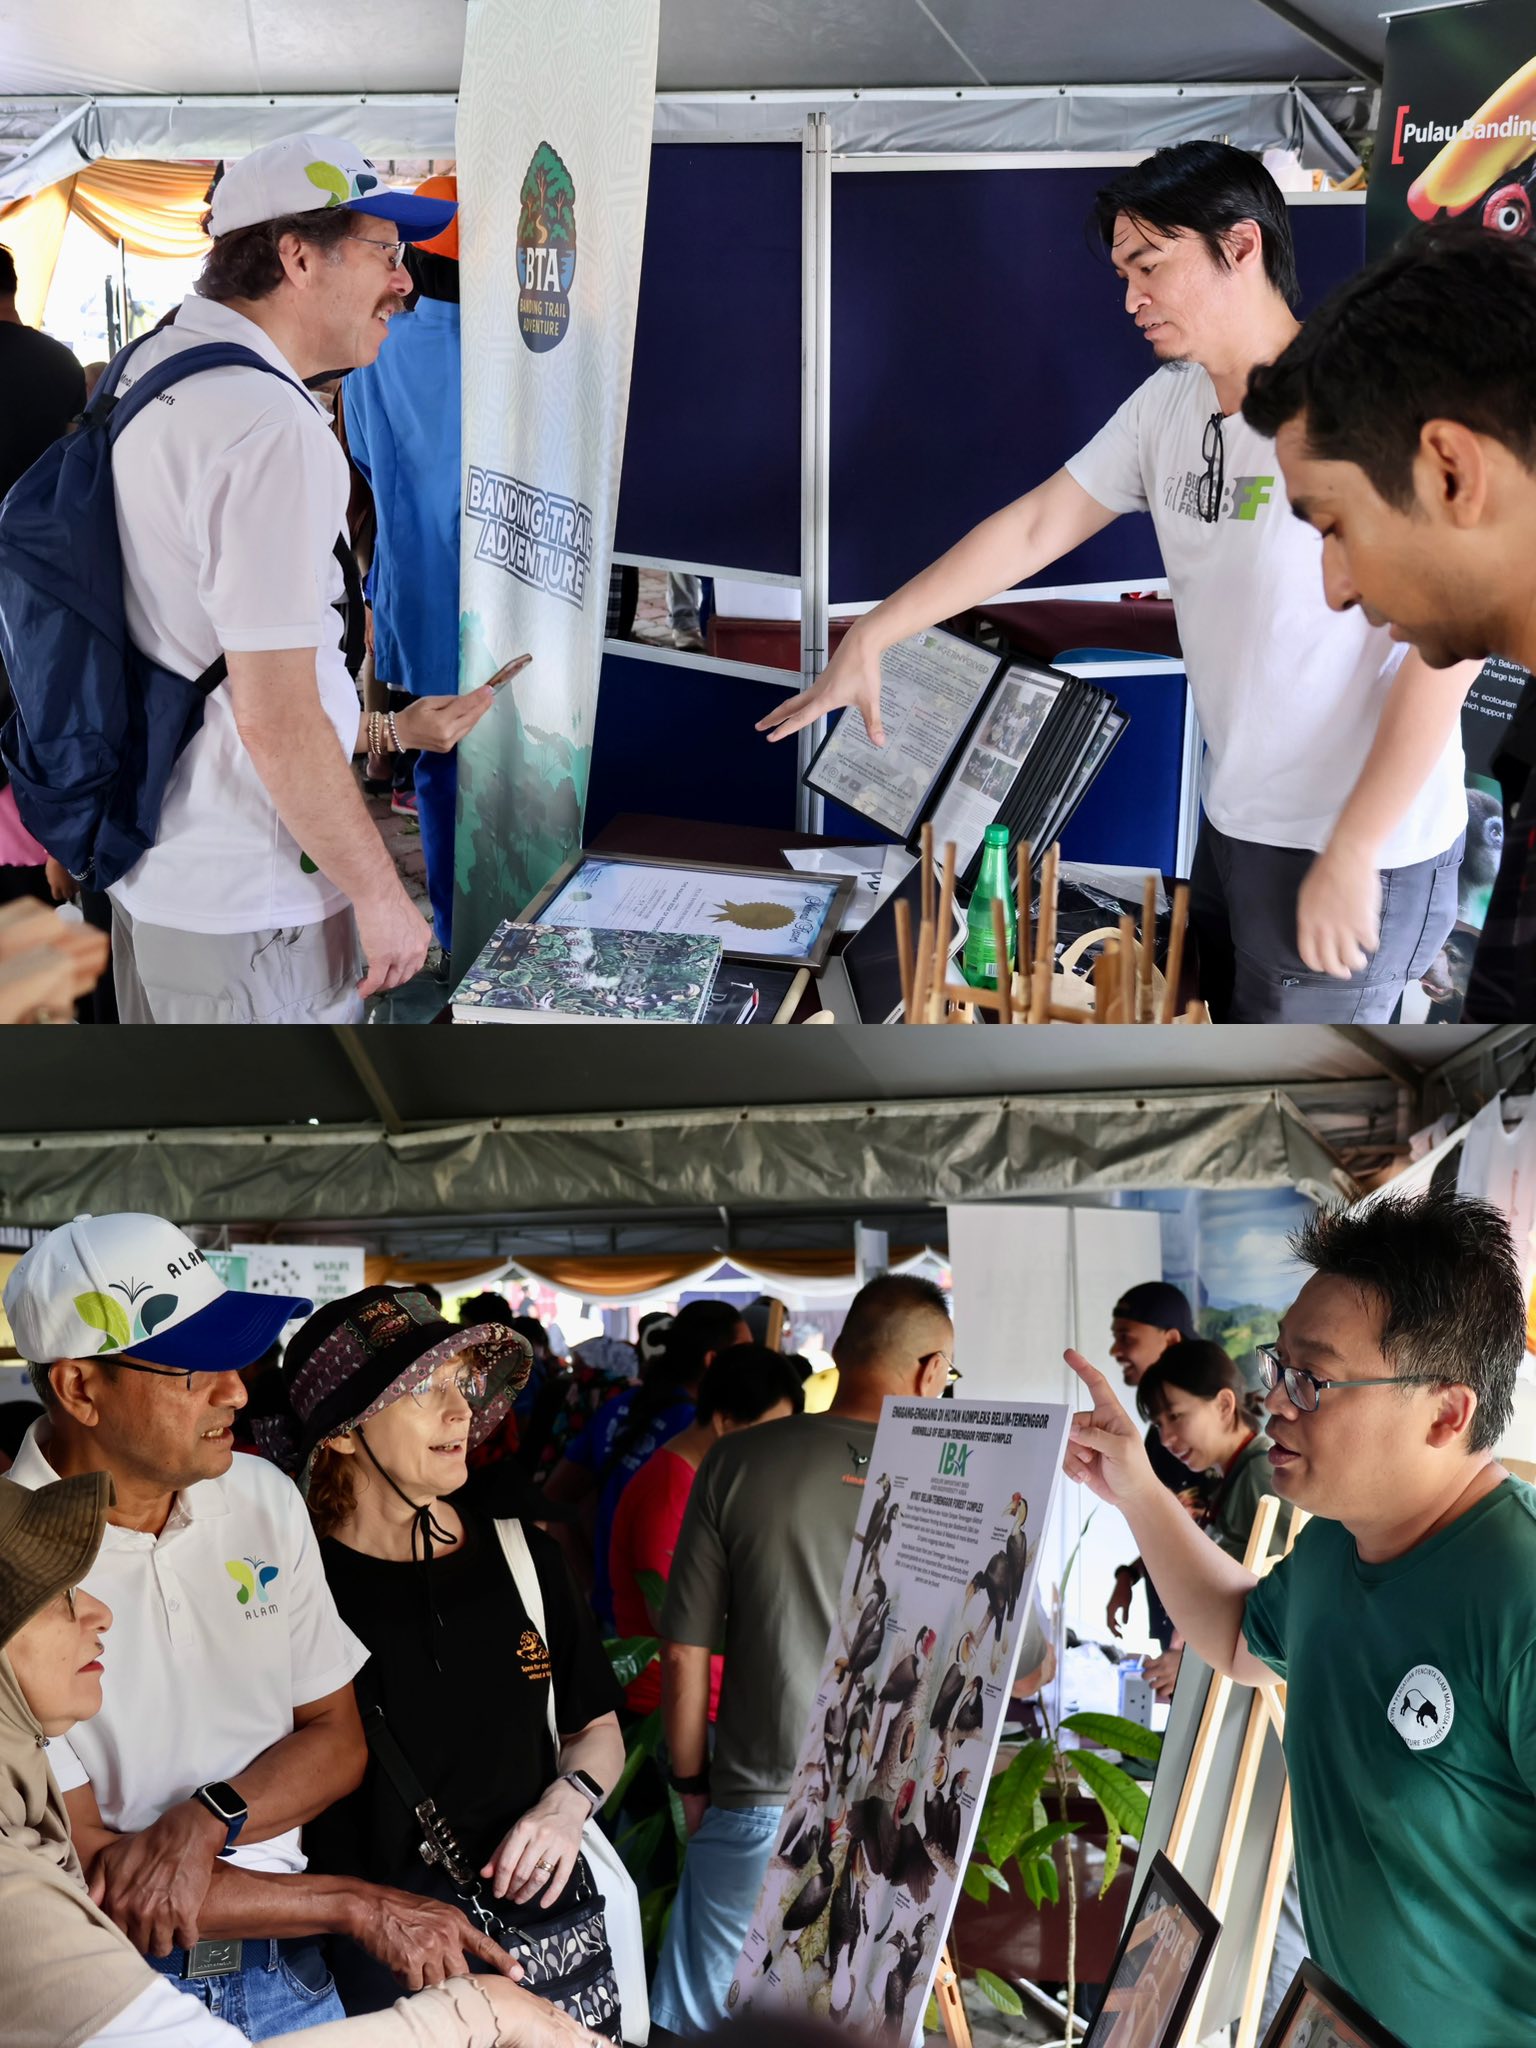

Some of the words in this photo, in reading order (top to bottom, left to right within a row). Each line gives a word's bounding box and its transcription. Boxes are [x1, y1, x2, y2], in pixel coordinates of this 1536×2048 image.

[1403, 120, 1458, 145] Pulau
[524, 247, 561, 293] BTA
[519, 298, 543, 316] BANDING
[544, 300, 567, 318] TRAIL
[523, 319, 560, 337] ADVENTURE
[157, 391, 176, 406] earts
[468, 474, 547, 539] BANDING
[478, 517, 585, 602] ADVENTURE
[1491, 670, 1507, 681] large
[1508, 675, 1526, 686] birds
[1470, 690, 1479, 698] for
[1481, 694, 1518, 709] ecotourism
[1480, 706, 1505, 719] support
[943, 1409, 961, 1423] HUTAN
[962, 1410, 991, 1425] KOMPLEKS
[990, 1411, 1050, 1429] BELUM-TEMENGGOR
[938, 1441, 971, 1477] IBA
[244, 1603, 279, 1621] ALAM
[1436, 1675, 1448, 1693] ALAM
[1443, 1692, 1452, 1726] MALAYSIA
[1422, 1728, 1444, 1746] SOCIETY
